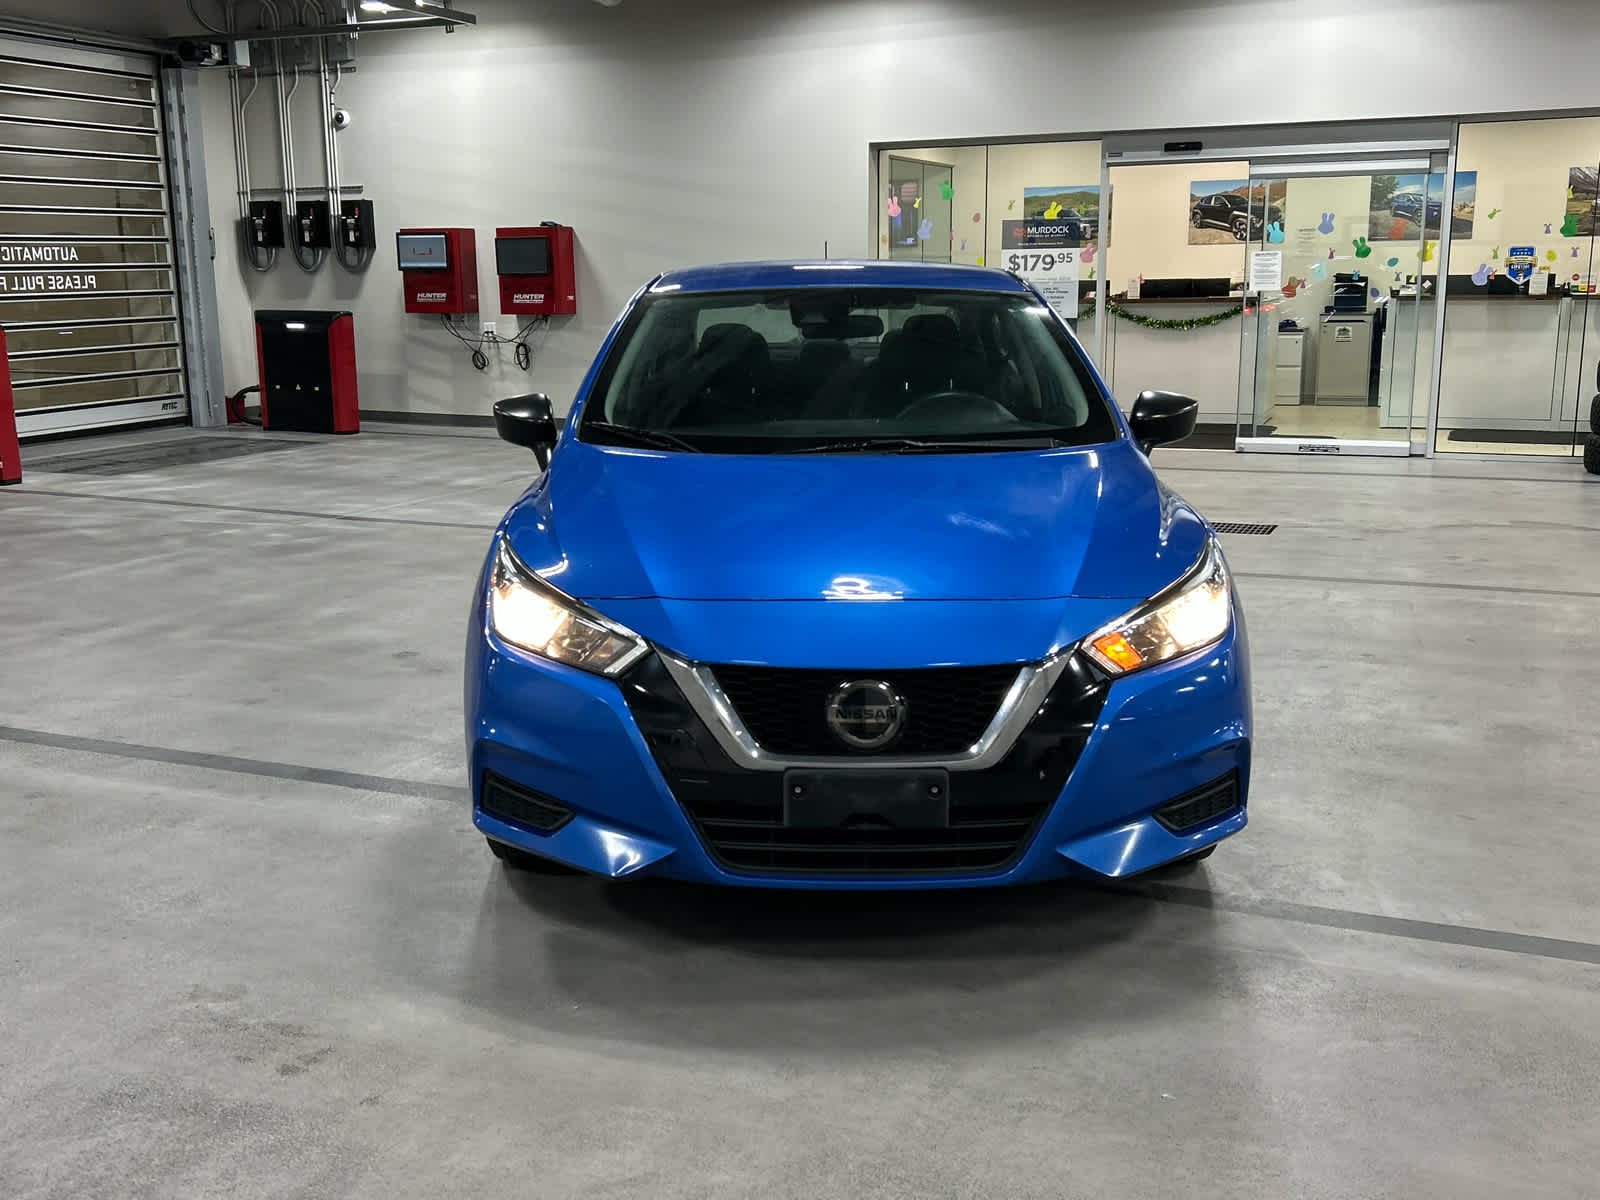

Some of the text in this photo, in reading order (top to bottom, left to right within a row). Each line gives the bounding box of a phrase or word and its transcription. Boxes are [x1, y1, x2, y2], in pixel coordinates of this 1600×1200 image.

[1027, 225, 1069, 234] MURDOCK
[1008, 252, 1073, 272] $179.95
[417, 292, 447, 300] HUNTER
[514, 293, 545, 301] HUNTER
[835, 708, 897, 720] NISSAN
